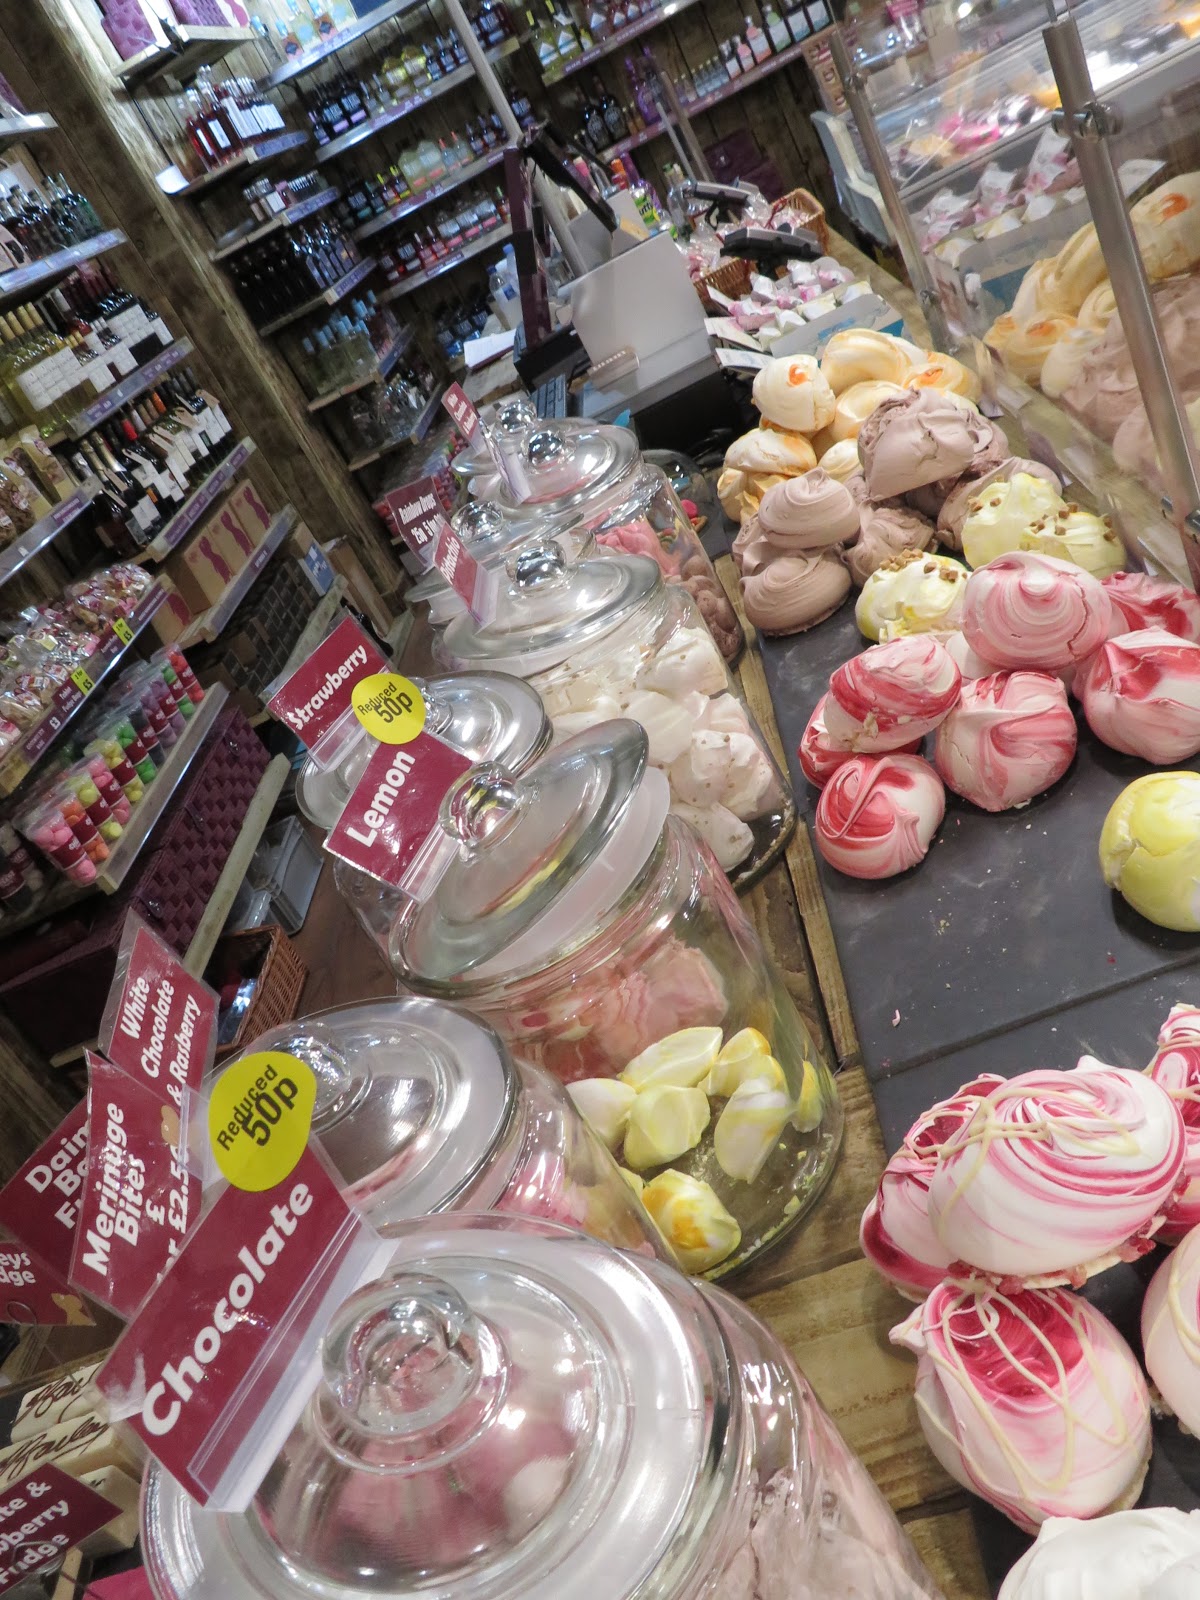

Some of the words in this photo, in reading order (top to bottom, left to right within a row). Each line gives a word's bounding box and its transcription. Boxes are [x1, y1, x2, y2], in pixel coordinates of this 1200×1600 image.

[288, 644, 369, 731] Strawberry
[357, 681, 397, 716] Reduced
[374, 692, 413, 724] 50p
[346, 750, 416, 848] Lemon
[121, 977, 150, 1039] White
[141, 979, 174, 1078] Chocolate
[169, 994, 201, 1084] Rasberry
[216, 1063, 279, 1151] Reduced
[241, 1075, 299, 1147] 50p
[114, 1153, 146, 1247] Bites
[146, 1198, 166, 1226] £
[142, 1182, 315, 1436] Chocolate
[26, 1481, 53, 1498] &
